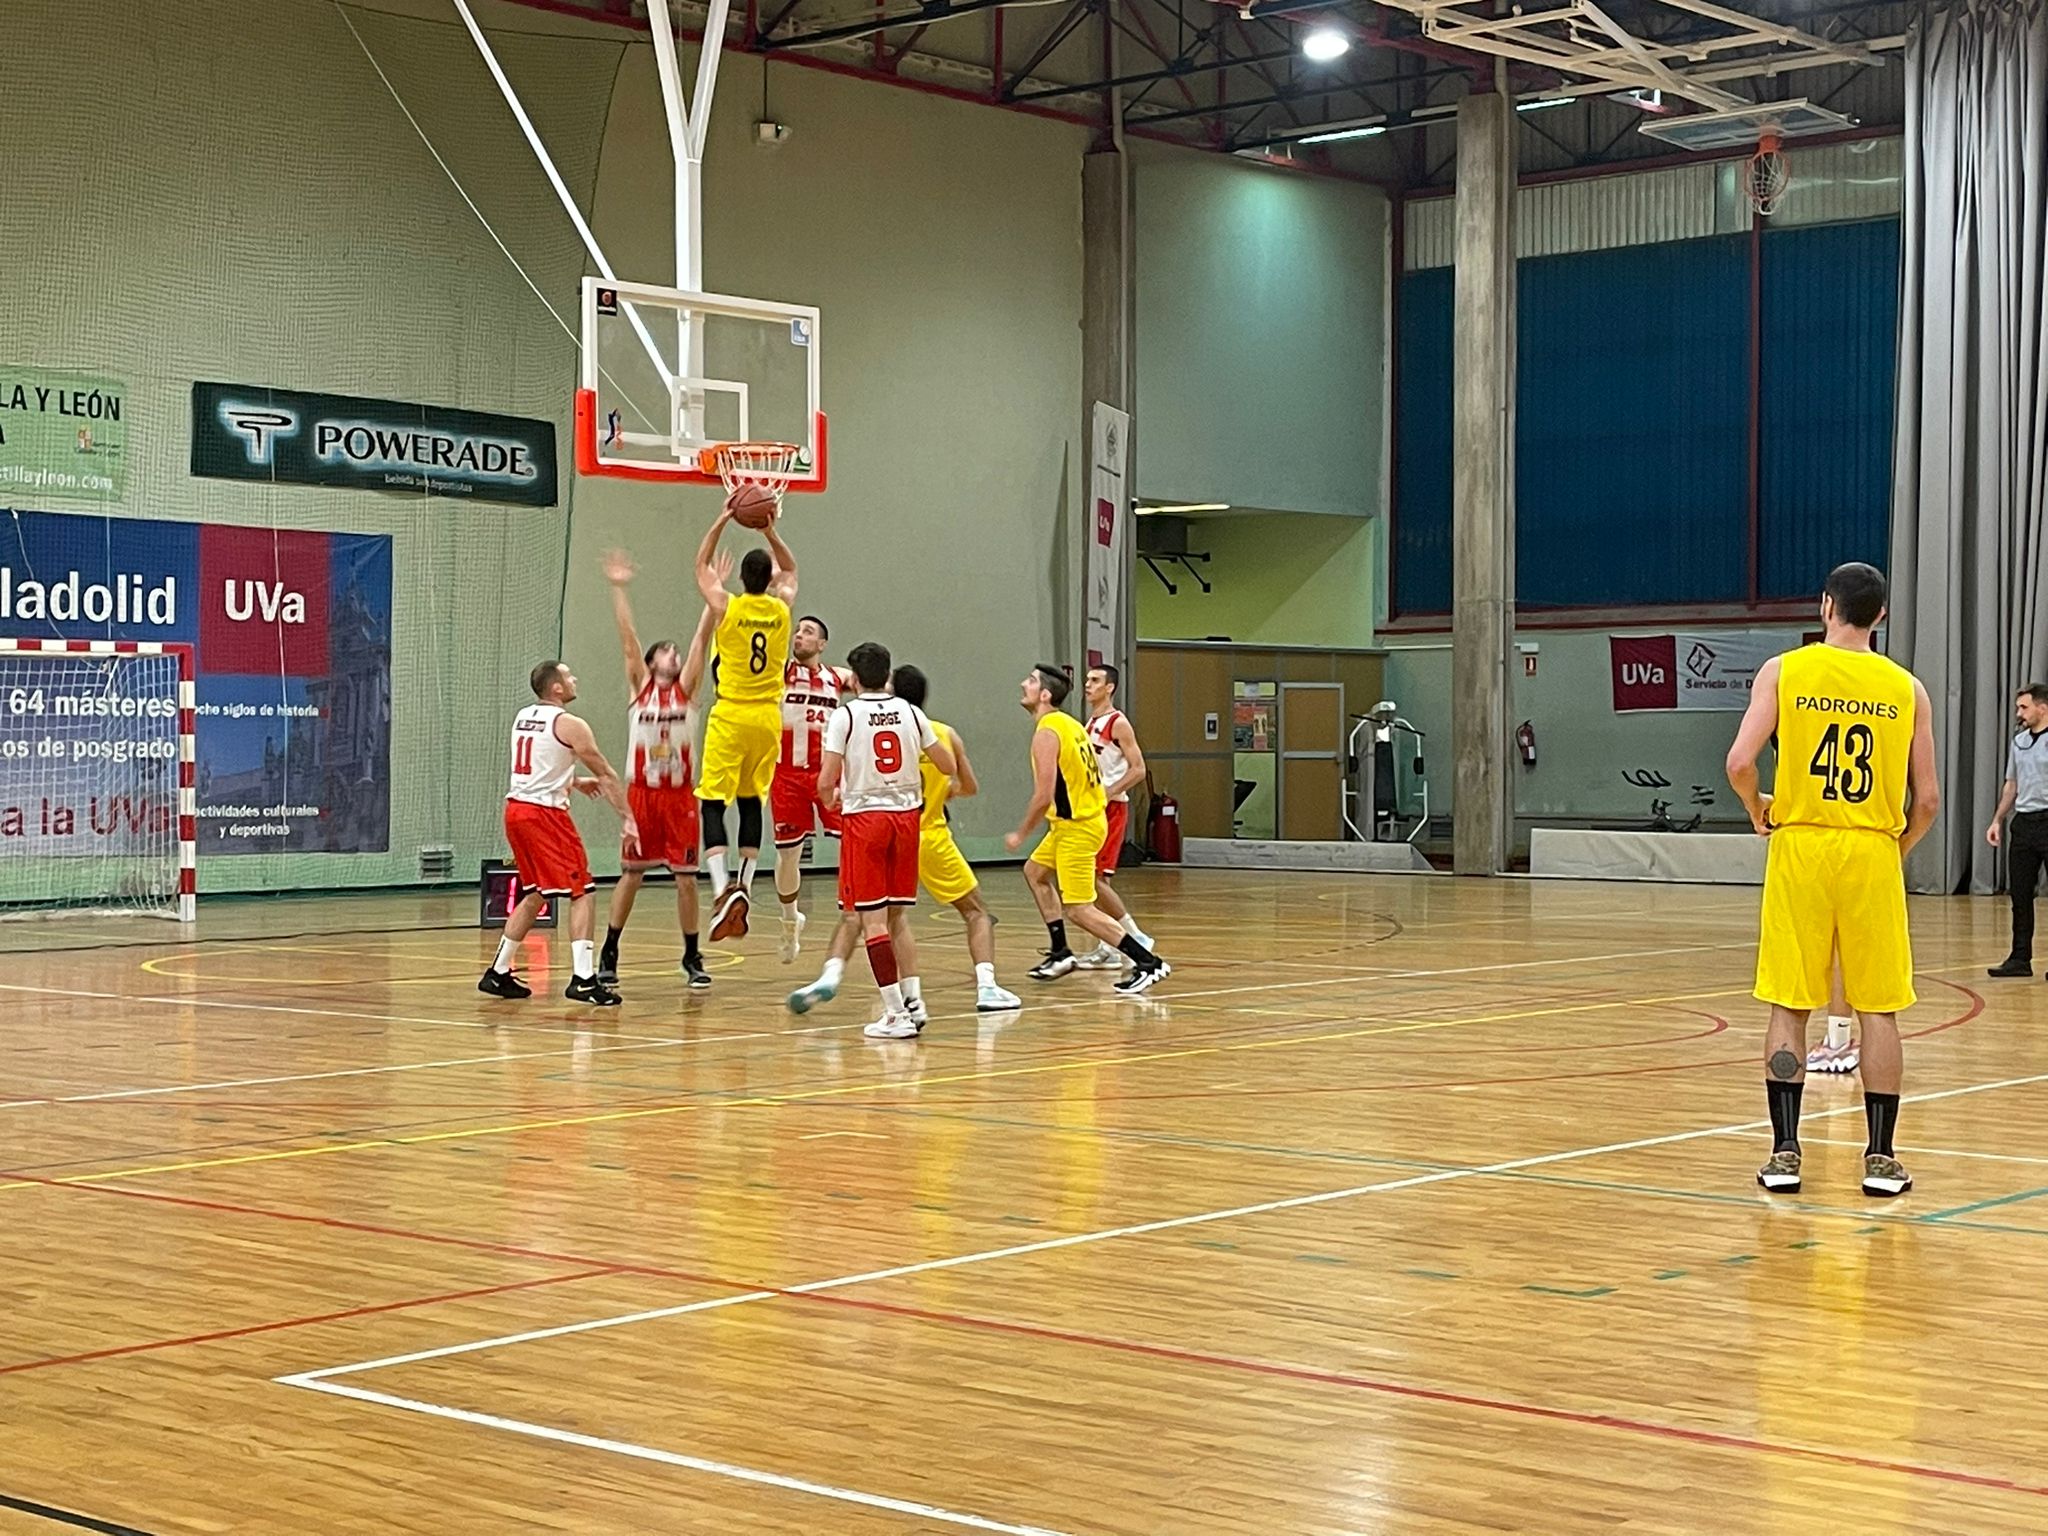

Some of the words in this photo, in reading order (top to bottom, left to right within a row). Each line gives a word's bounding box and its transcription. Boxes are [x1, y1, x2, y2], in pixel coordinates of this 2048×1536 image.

[35, 387, 50, 412] Y
[59, 389, 120, 421] LEÓN
[318, 425, 528, 476] POWERADE
[0, 567, 176, 625] ladolid
[225, 579, 305, 623] UVa
[750, 631, 767, 675] 8
[1622, 663, 1665, 685] UVa
[1685, 679, 1727, 689] Servicio
[9, 689, 45, 715] 64
[55, 691, 177, 717] másteres
[223, 703, 256, 718] siglos
[260, 704, 274, 716] de
[277, 704, 319, 717] historia
[806, 708, 825, 724] 24
[1796, 696, 1899, 720] PADRONES
[868, 711, 901, 727] JORGE
[37, 736, 66, 758] de
[73, 737, 176, 763] posgrado
[513, 735, 533, 775] 11
[873, 730, 903, 774] 9
[1809, 723, 1874, 804] 43
[1, 806, 25, 836] a
[41, 798, 75, 836] la
[263, 804, 320, 817] culturales
[219, 825, 227, 839] y
[229, 823, 291, 838] deportivas
